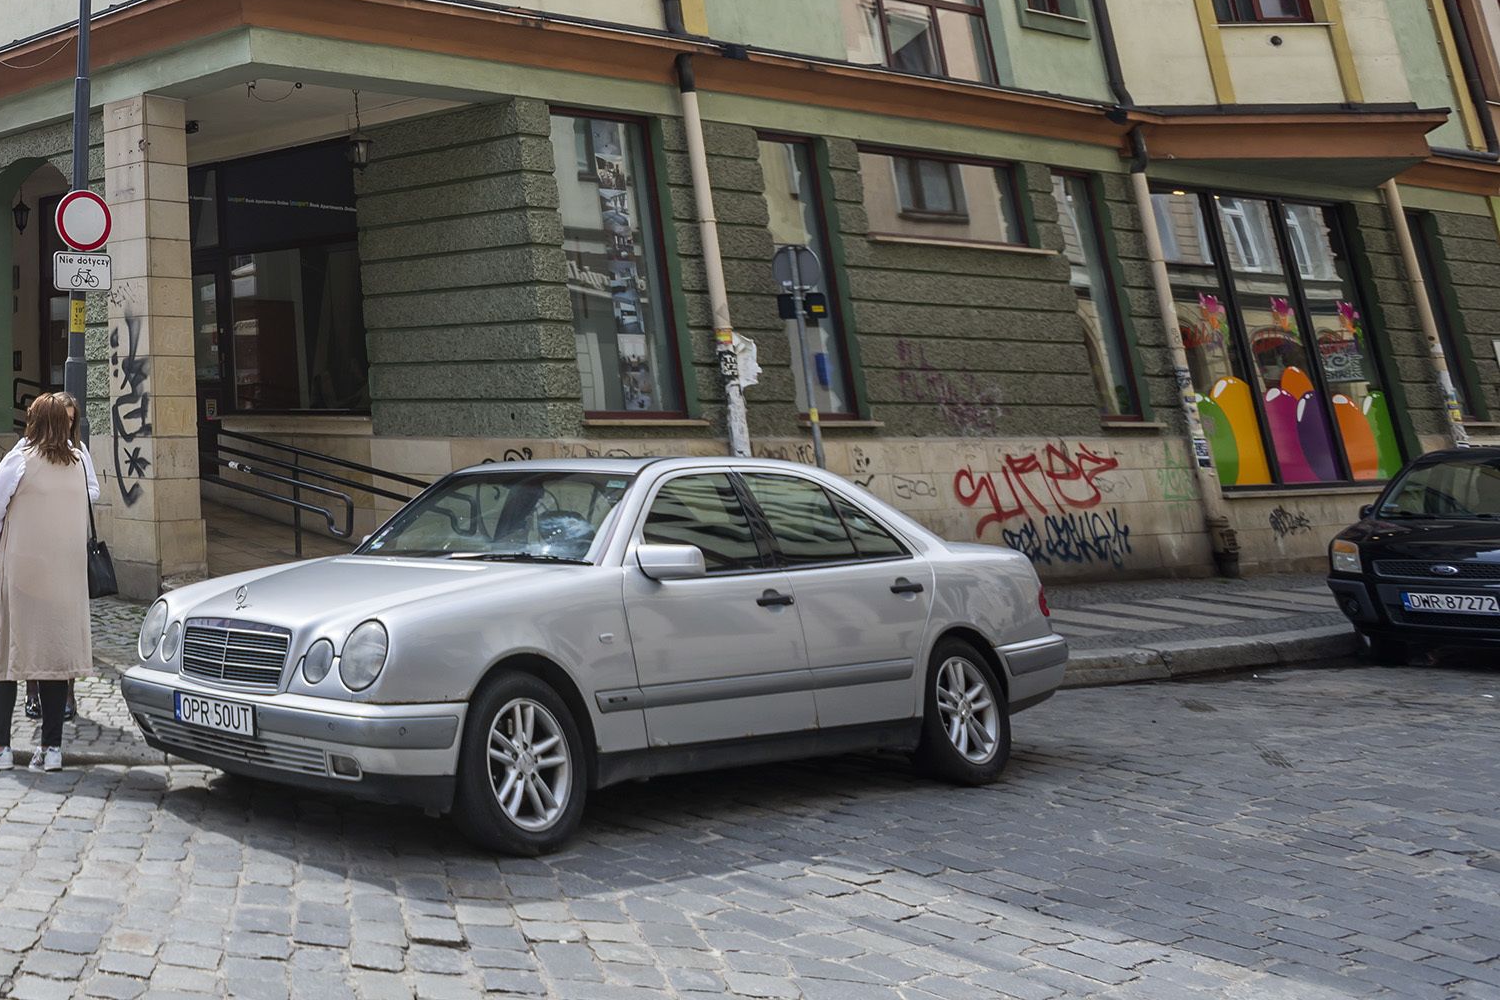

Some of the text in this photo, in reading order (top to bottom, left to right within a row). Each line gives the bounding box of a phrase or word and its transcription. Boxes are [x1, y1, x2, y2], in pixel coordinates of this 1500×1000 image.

[59, 255, 110, 268] Nie dotyczy
[1409, 593, 1498, 612] DWR 87272
[182, 697, 210, 725] OPR
